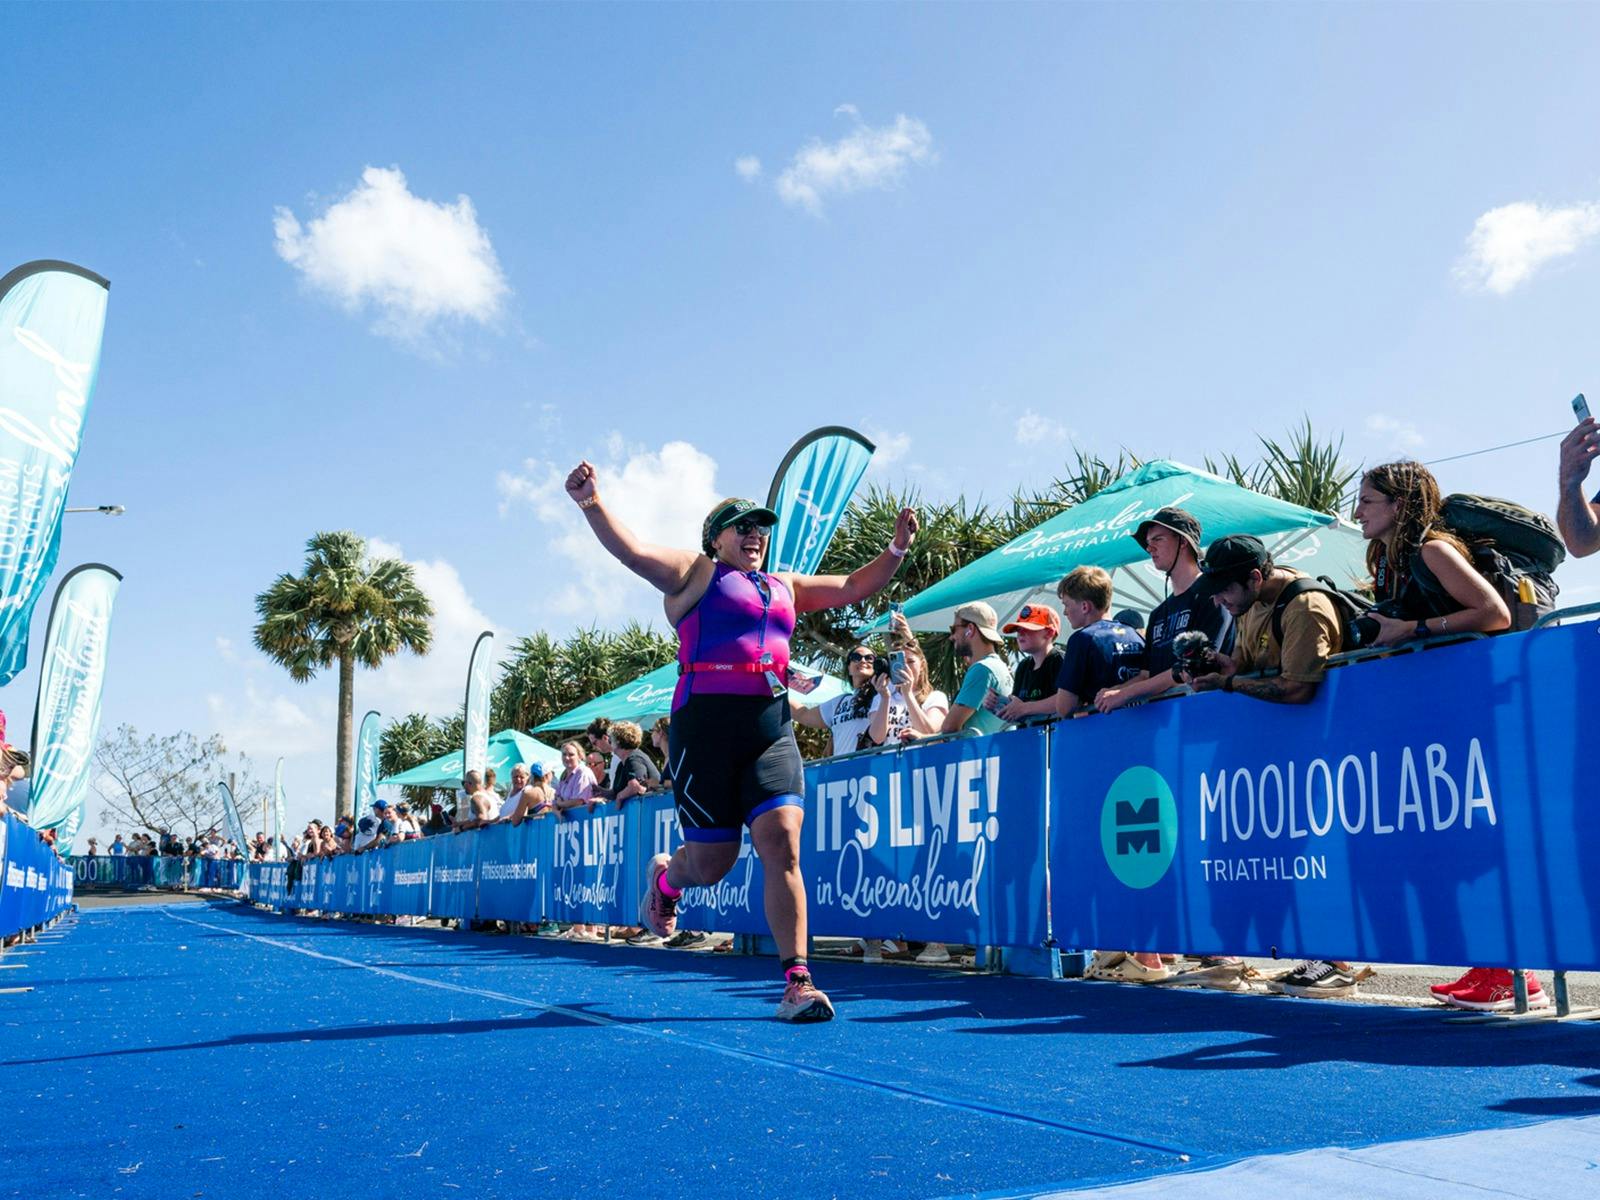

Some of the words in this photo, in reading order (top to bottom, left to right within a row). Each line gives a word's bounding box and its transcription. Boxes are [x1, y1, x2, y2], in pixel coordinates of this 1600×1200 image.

[18, 464, 43, 555] EVENTS
[1023, 528, 1132, 560] AUSTRALIA
[816, 775, 878, 851] IT'S
[889, 756, 1000, 847] LIVE!
[1199, 737, 1497, 842] MOOLOOLABA
[553, 820, 580, 867] IT'S
[583, 814, 625, 866] LIVE!
[1199, 854, 1327, 882] TRIATHLON
[554, 883, 562, 901] in
[562, 854, 619, 910] Queensland
[676, 853, 753, 916] ueensland
[816, 875, 834, 906] in
[836, 829, 986, 920] Queensland
